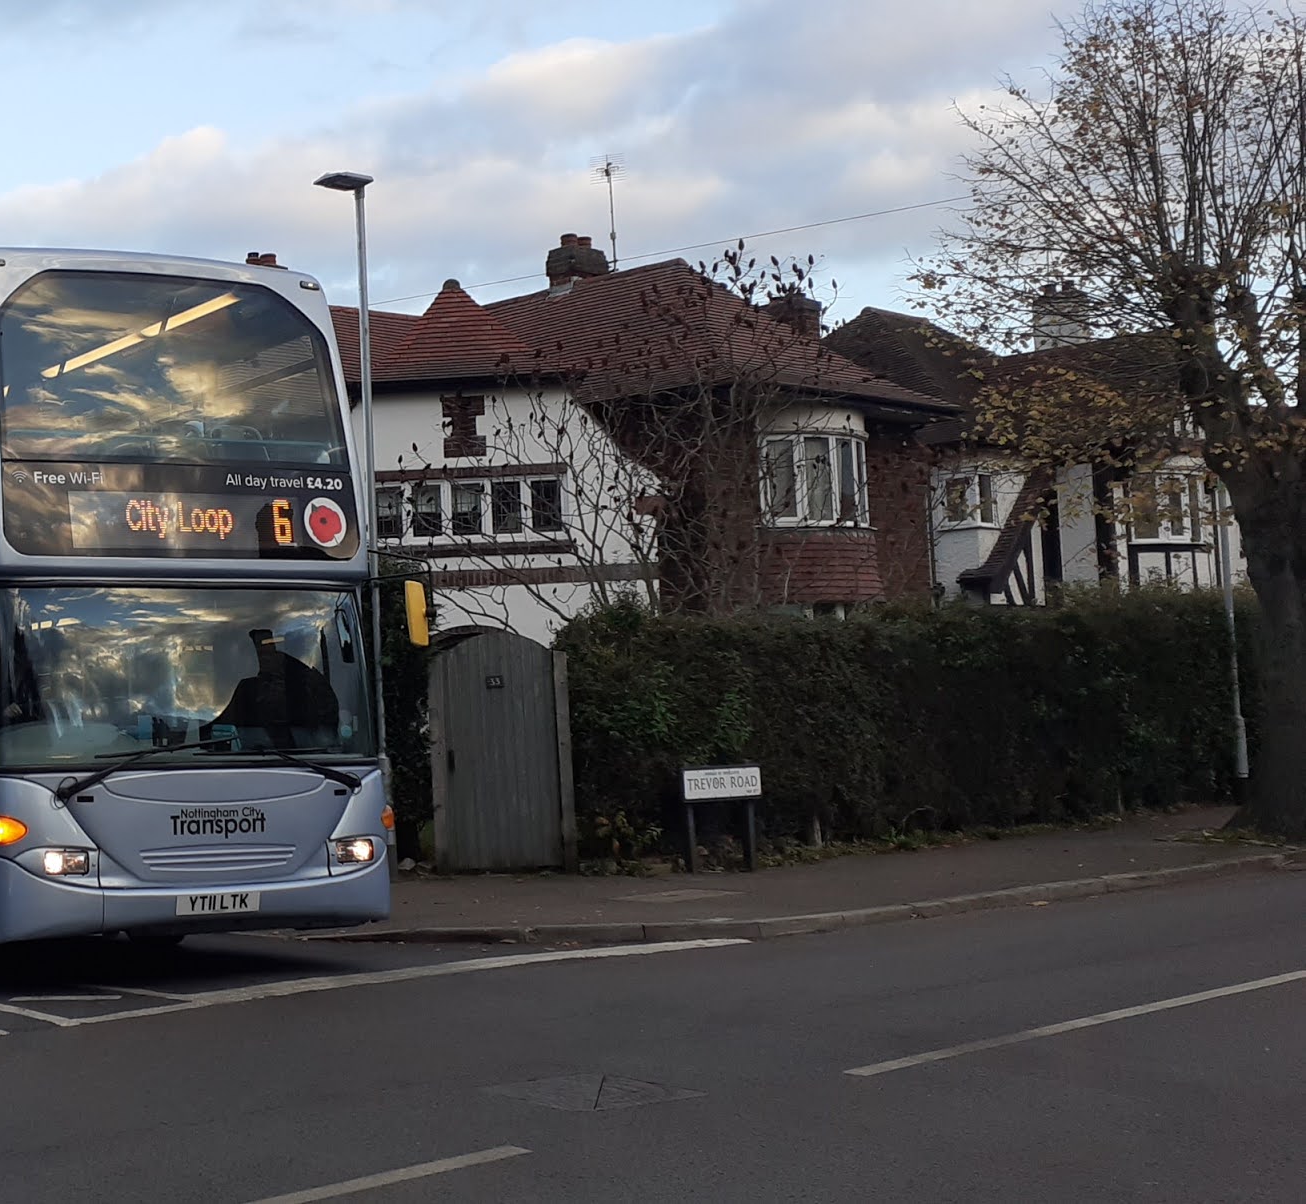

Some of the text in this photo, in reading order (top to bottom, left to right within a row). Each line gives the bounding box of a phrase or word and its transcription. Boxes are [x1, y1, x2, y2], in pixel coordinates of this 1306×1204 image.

[34, 471, 104, 484] Free Wi-Fi
[225, 473, 343, 490] All day travel £4.20
[126, 500, 234, 540] City Loop
[272, 498, 293, 544] 6
[687, 775, 758, 792] TREVOR ROAD
[180, 806, 261, 820] Nottingham City
[170, 813, 266, 839] Transport
[189, 893, 250, 911] YT11 LTK
